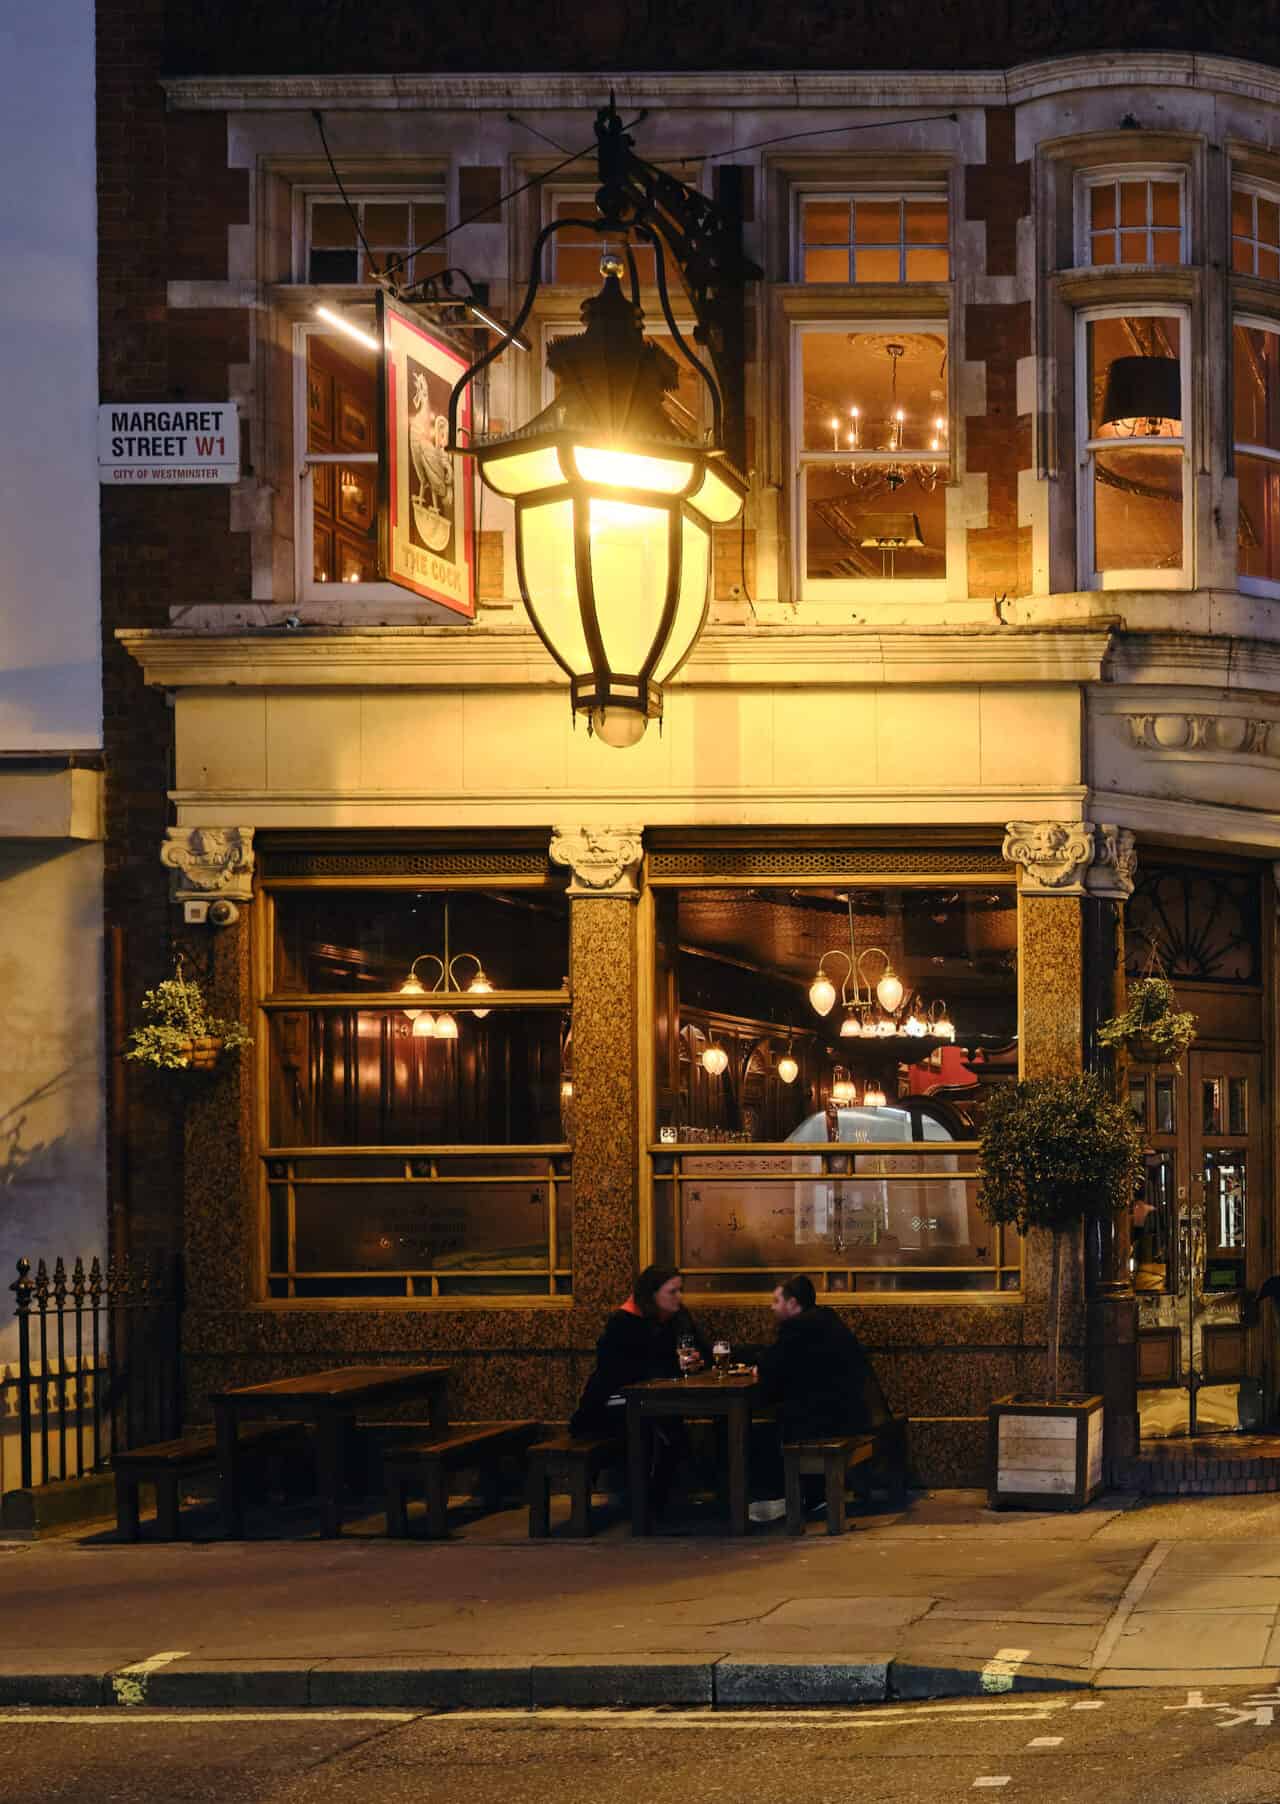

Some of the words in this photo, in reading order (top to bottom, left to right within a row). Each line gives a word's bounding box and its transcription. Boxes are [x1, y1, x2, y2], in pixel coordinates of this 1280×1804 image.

[111, 411, 223, 432] MARGARET
[111, 436, 188, 457] STREET
[195, 435, 225, 456] W1
[113, 469, 135, 479] CITY
[136, 469, 147, 479] OF
[151, 468, 218, 479] WESTMINSTER
[431, 559, 461, 593] COCK
